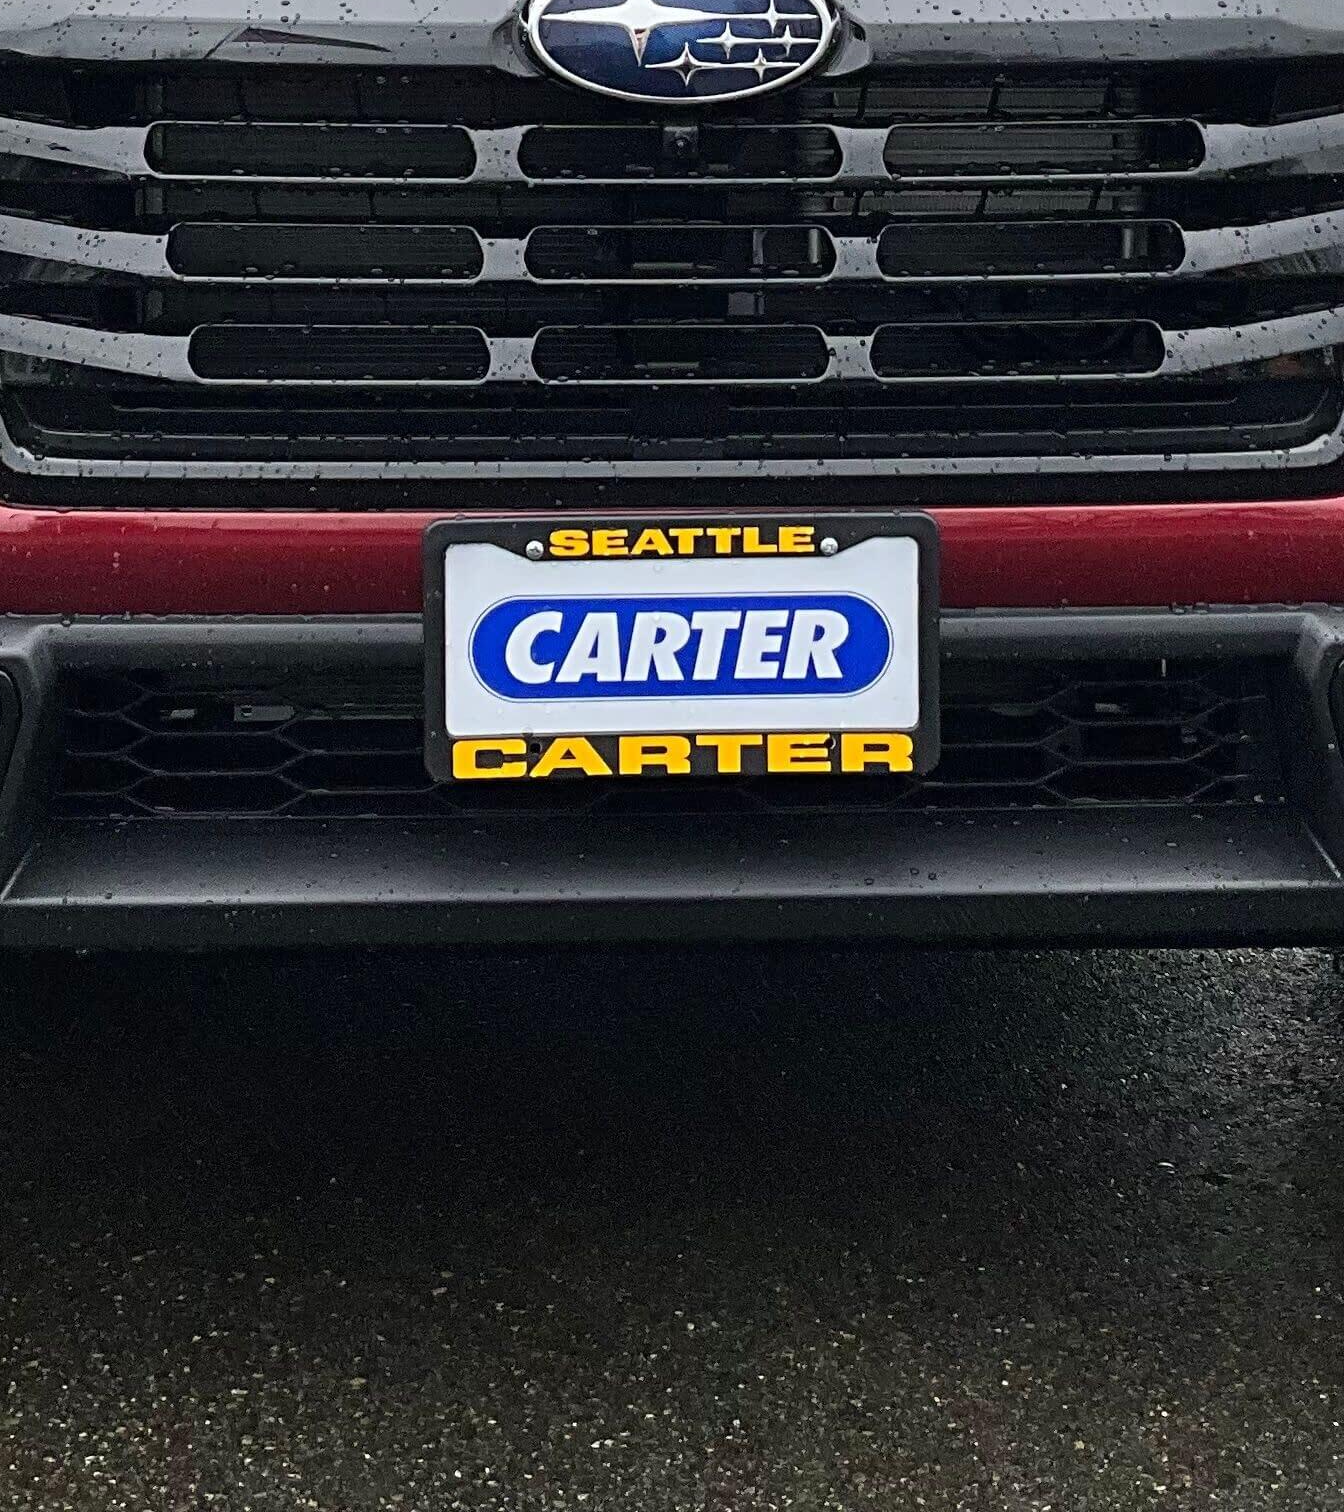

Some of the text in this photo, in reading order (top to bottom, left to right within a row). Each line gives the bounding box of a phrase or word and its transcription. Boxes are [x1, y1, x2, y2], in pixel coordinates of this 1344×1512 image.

[549, 526, 815, 556] SEATTLE
[505, 608, 850, 684] CARTER
[452, 733, 914, 779] CARTER
